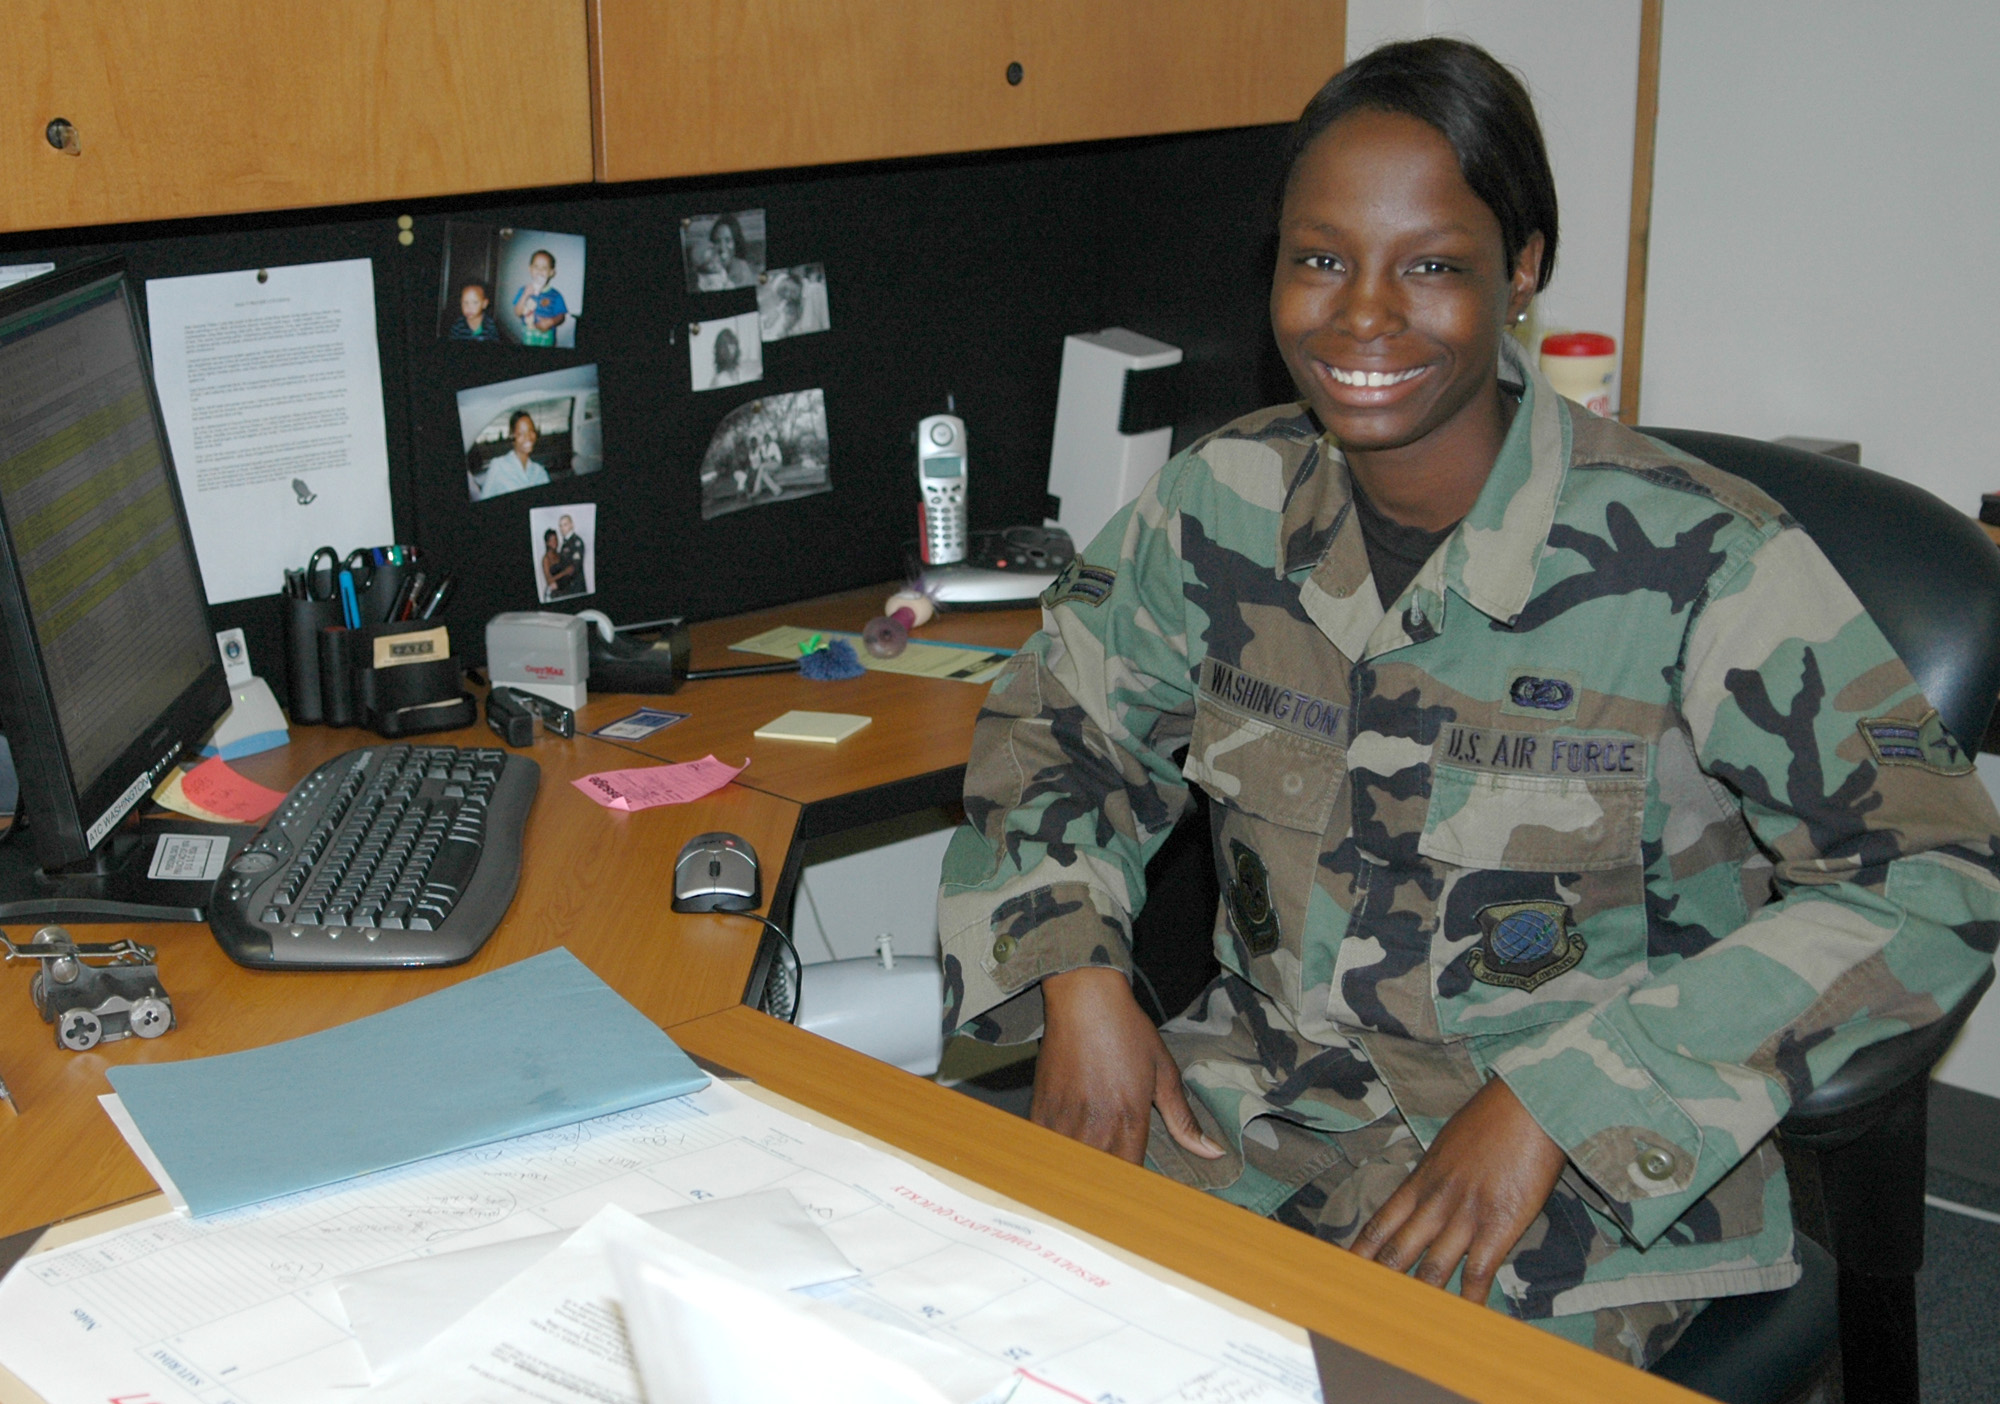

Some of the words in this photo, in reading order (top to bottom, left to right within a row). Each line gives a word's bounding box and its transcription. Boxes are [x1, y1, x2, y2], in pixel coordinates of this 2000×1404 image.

[1211, 663, 1344, 737] WASHINGTON
[1449, 728, 1481, 764] U.S.
[1491, 734, 1538, 769] AIR
[1551, 739, 1635, 773] FORCE
[102, 776, 149, 828] WASHINGTON
[891, 1185, 954, 1219] QUICKLY
[953, 1215, 1043, 1253] COMPLAINTS
[1039, 1249, 1110, 1288] RESOLVE
[71, 1308, 101, 1332] Notes
[152, 1349, 204, 1387] SATURDAY
